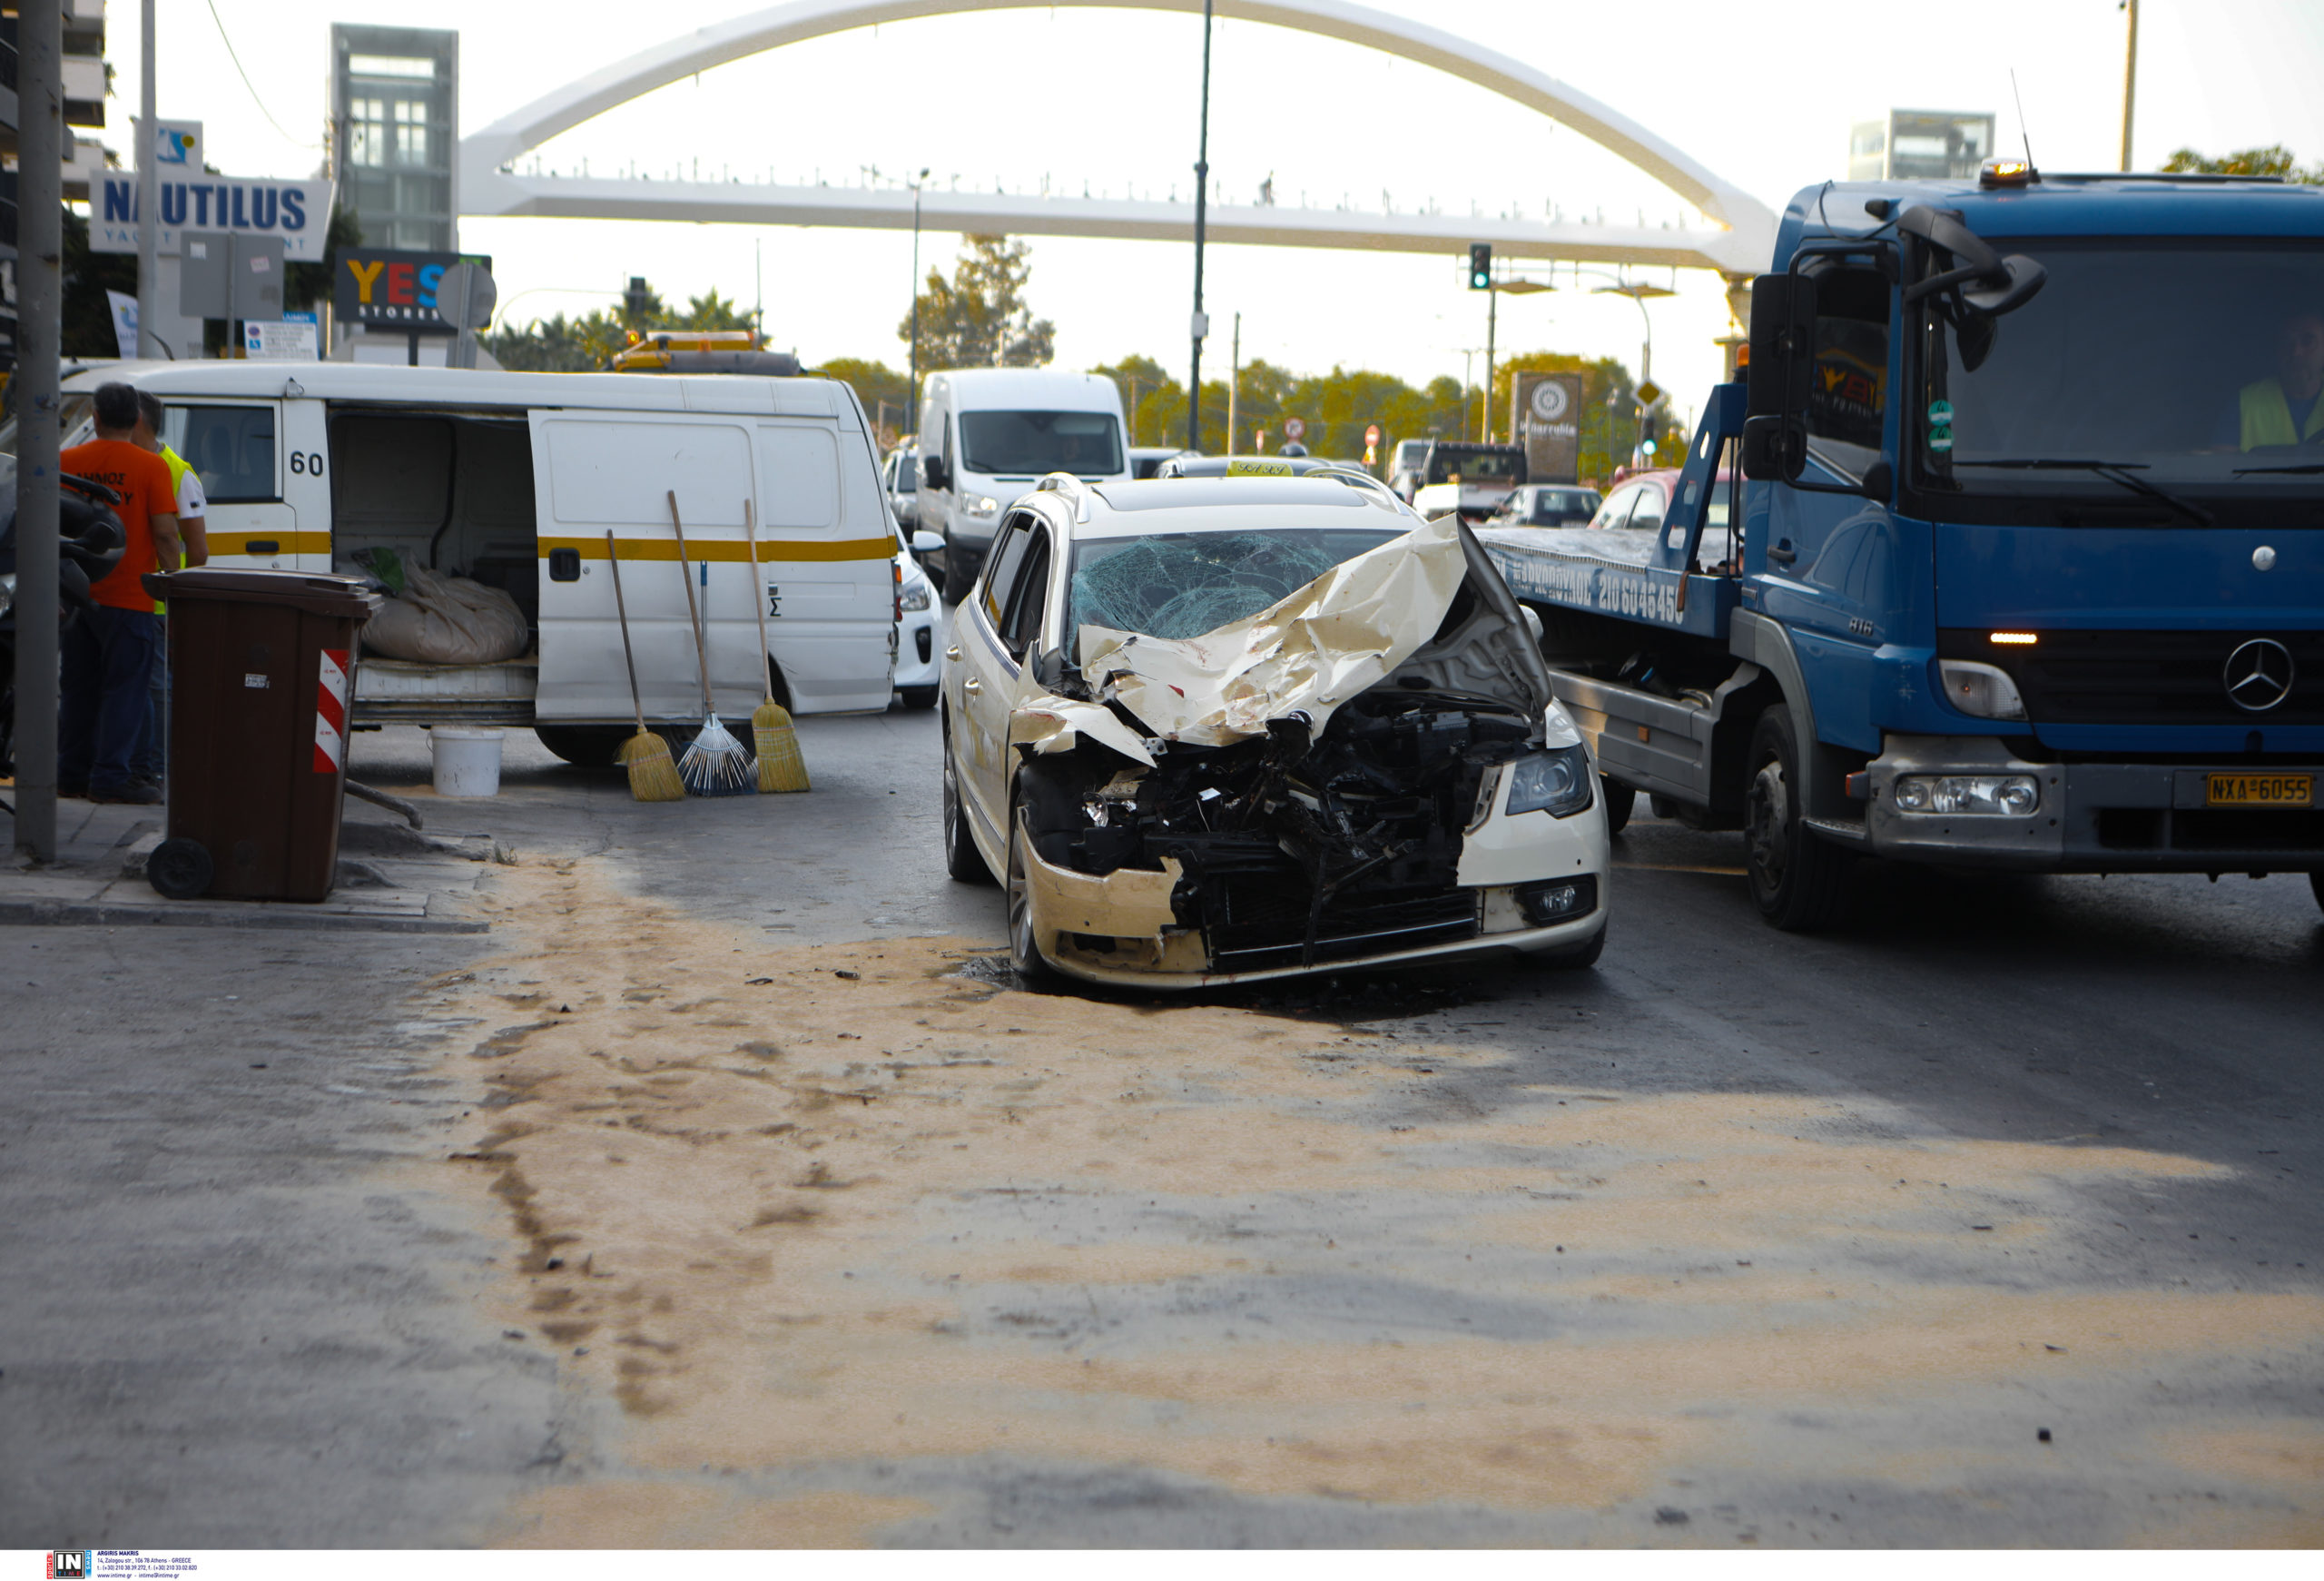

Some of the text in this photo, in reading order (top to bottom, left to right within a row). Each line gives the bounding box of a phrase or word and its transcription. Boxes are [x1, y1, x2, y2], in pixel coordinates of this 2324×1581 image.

[103, 179, 307, 231] NUTILUS
[347, 259, 445, 308] YES
[290, 450, 324, 478] 60
